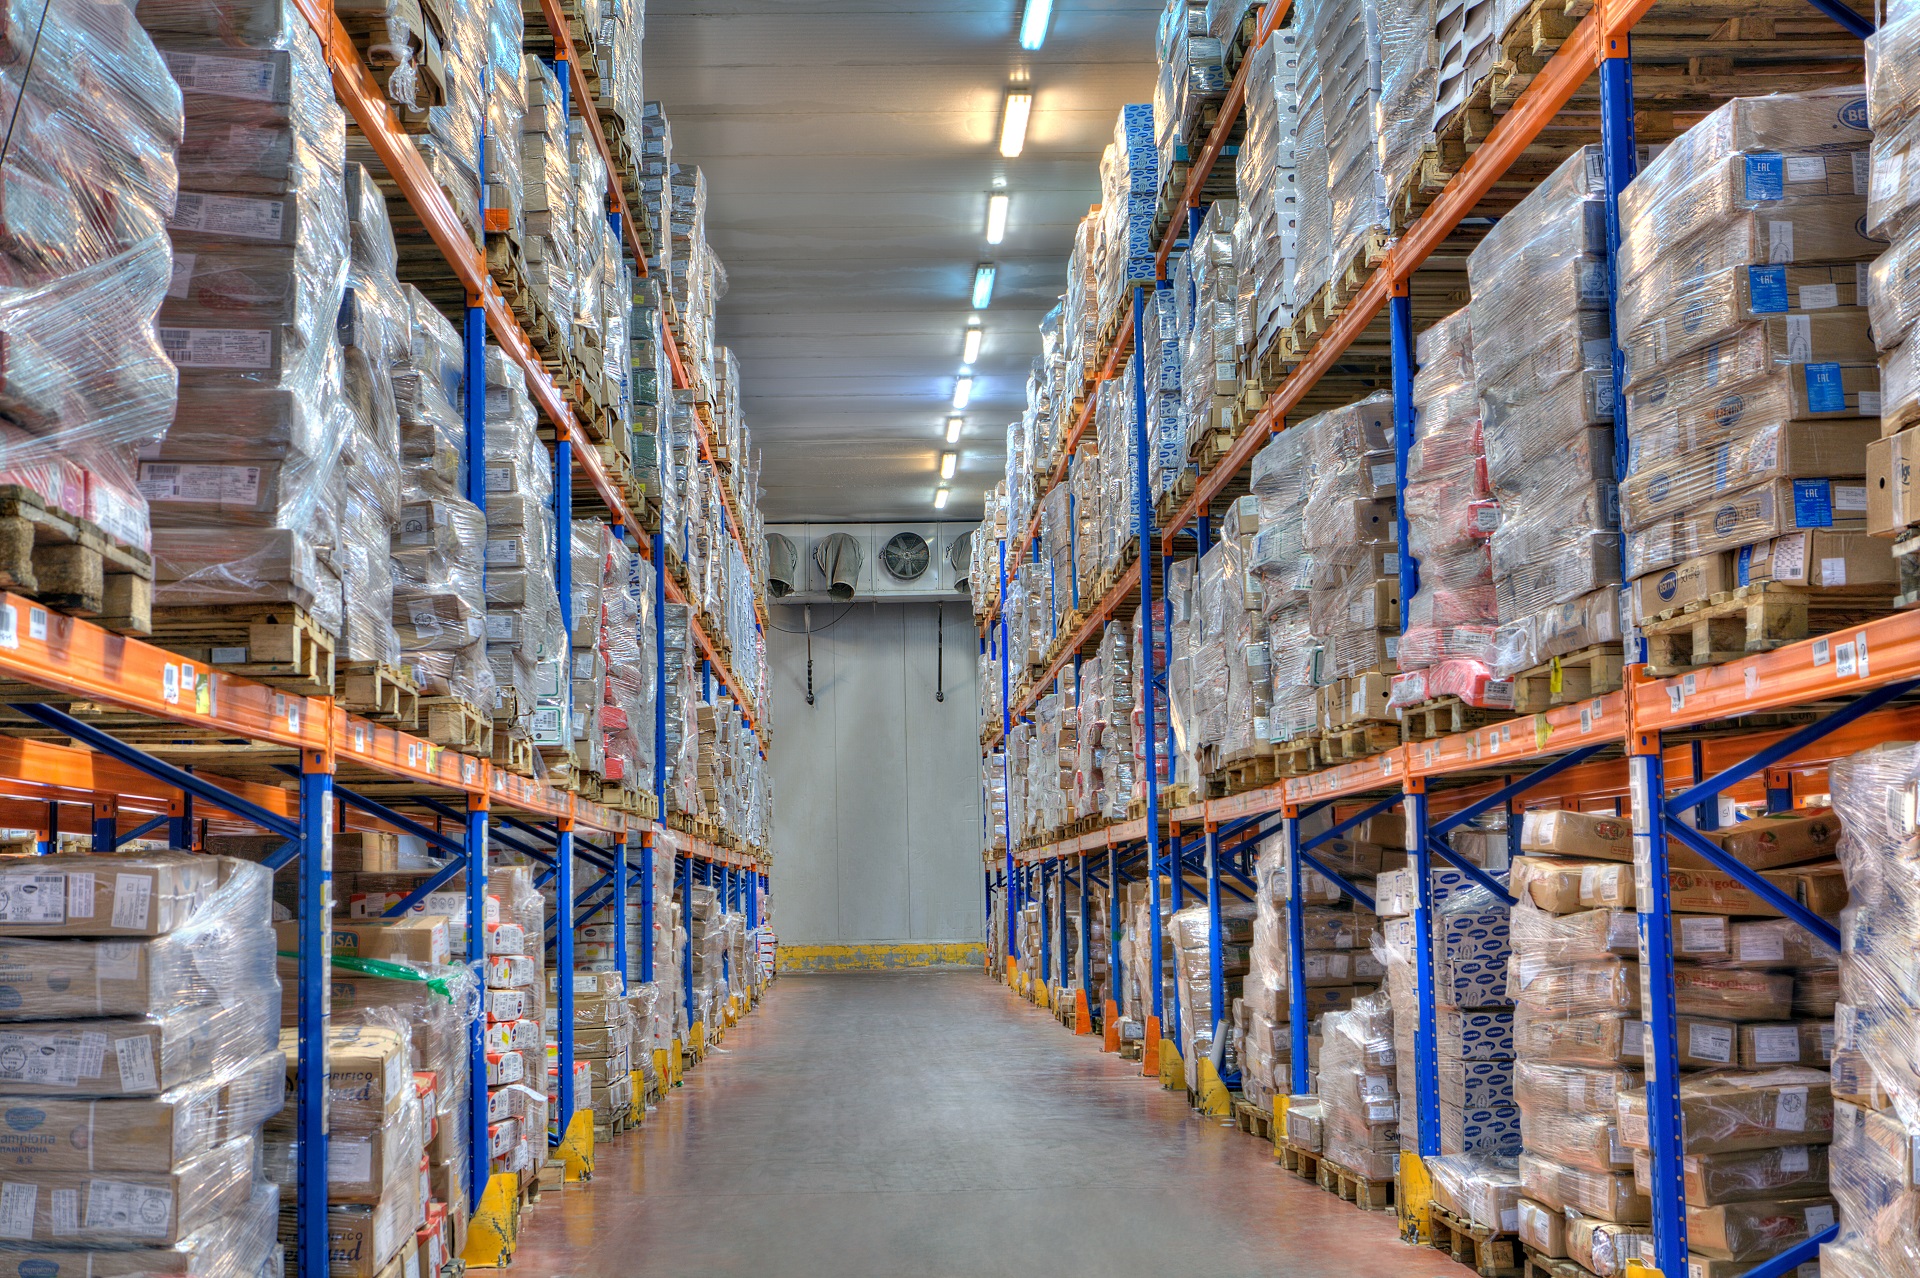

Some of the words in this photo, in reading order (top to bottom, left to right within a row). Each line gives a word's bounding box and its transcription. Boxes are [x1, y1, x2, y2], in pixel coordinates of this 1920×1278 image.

[332, 935, 354, 948] ISA
[28, 1067, 48, 1075] 21236
[0, 1133, 56, 1146] amplona
